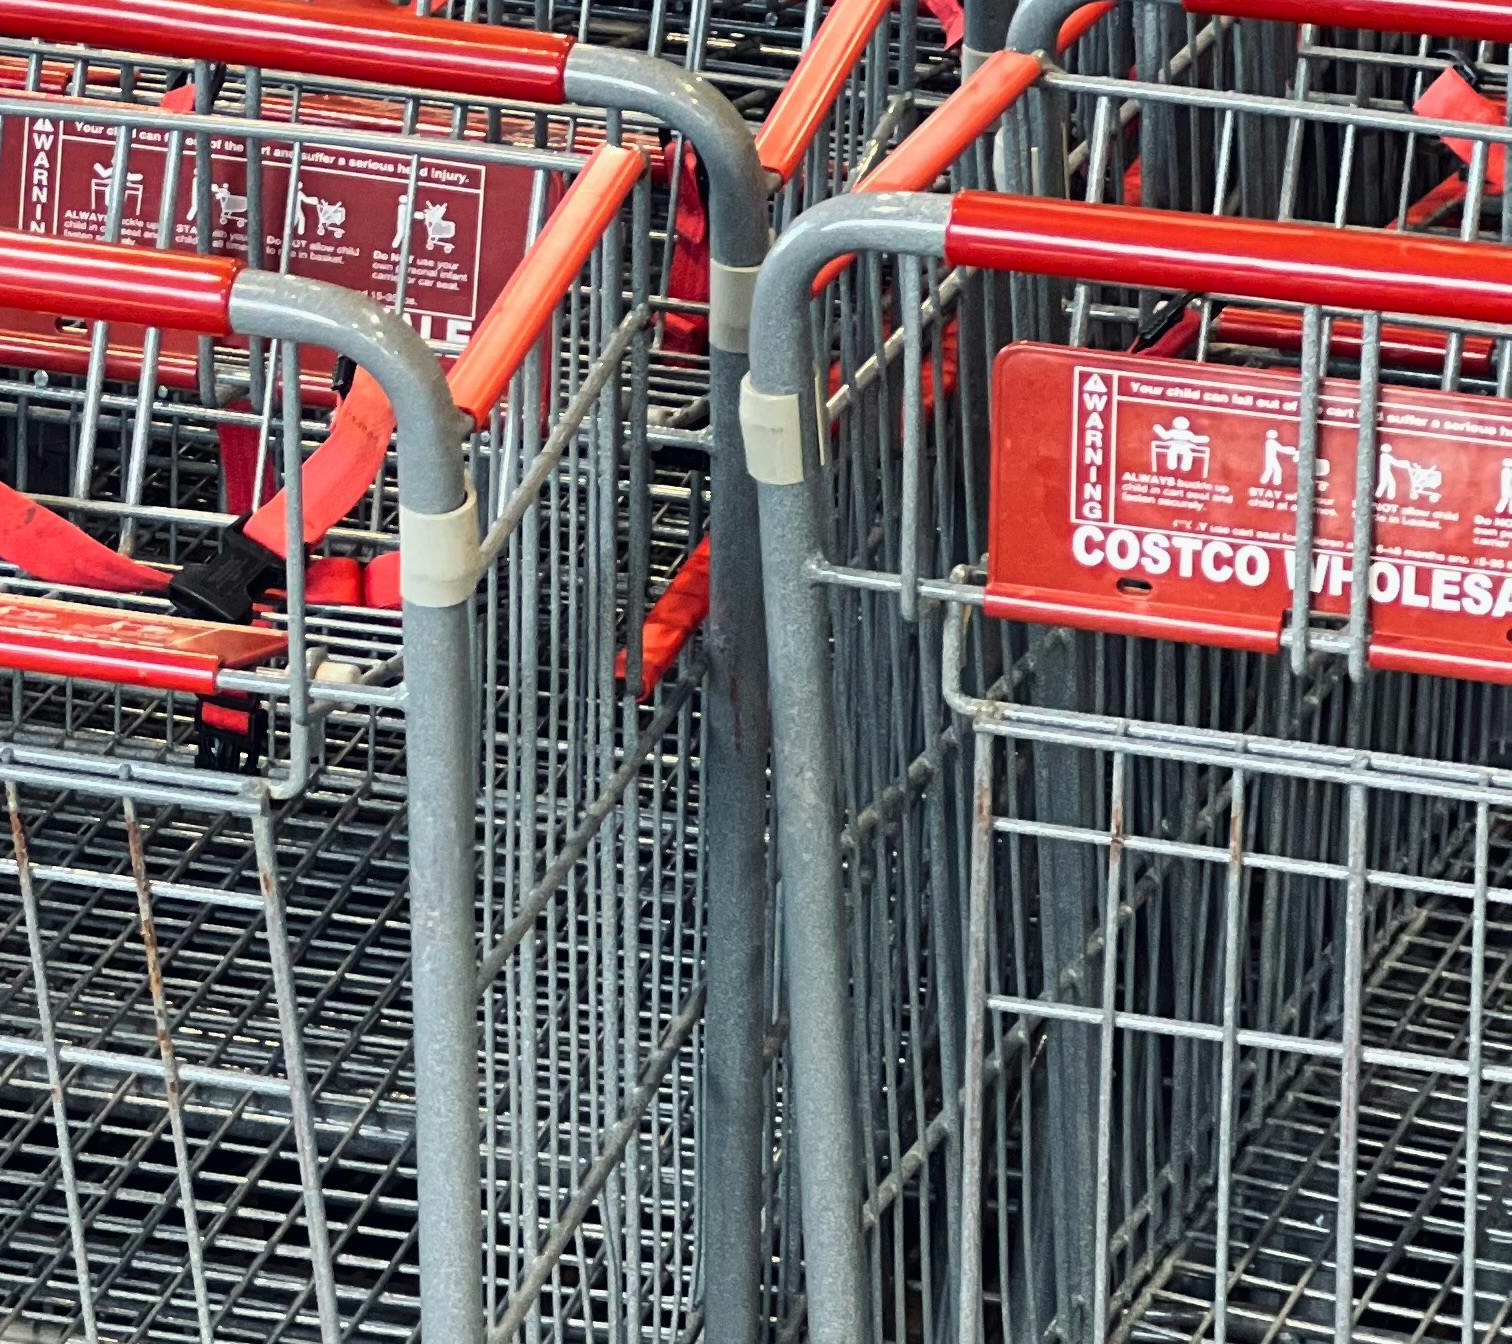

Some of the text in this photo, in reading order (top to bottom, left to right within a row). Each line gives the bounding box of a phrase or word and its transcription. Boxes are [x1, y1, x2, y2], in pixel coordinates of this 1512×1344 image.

[74, 121, 470, 184] Your can the suffer a serious hed injury.
[30, 133, 55, 233] WARNIN
[175, 224, 197, 234] STA
[309, 242, 335, 253] allow
[336, 245, 360, 257] child
[373, 250, 388, 260] Do
[416, 256, 435, 267] use
[1130, 381, 1165, 397] Your
[1166, 386, 1201, 401] child
[1203, 391, 1229, 404] can
[1232, 392, 1254, 407] fall
[1256, 397, 1280, 409] out
[1283, 400, 1298, 411] of
[1326, 407, 1355, 419] cart
[1443, 421, 1497, 436] serious
[1082, 393, 1108, 520] WARNING
[1121, 471, 1176, 486] ALWAYS
[1248, 487, 1282, 499] STAY
[1072, 525, 1270, 587] COSTCO
